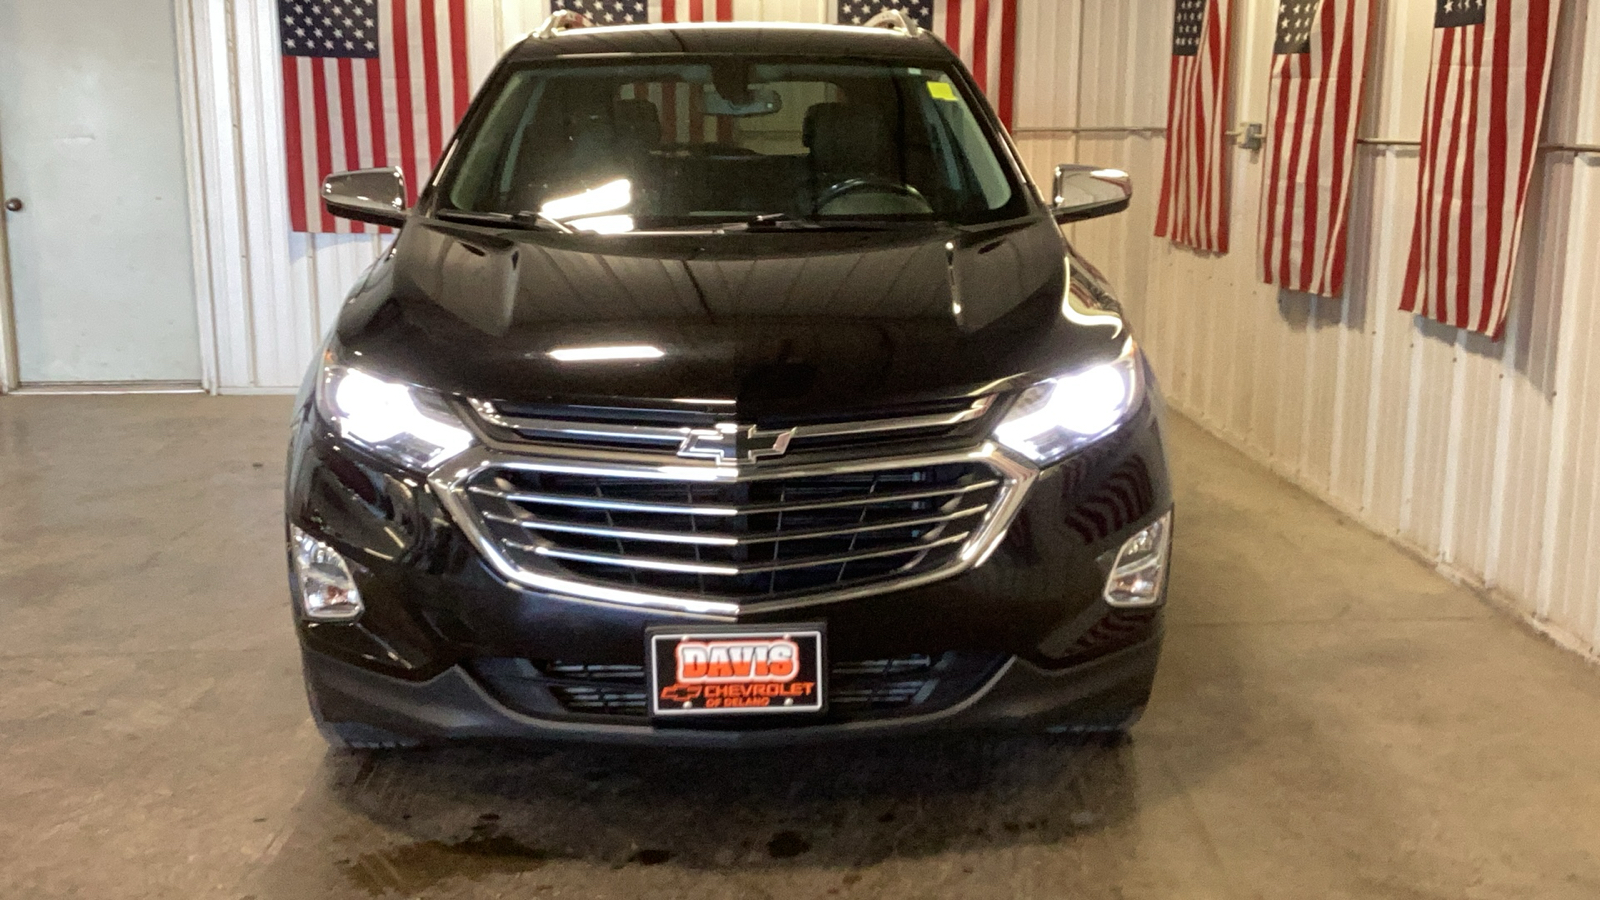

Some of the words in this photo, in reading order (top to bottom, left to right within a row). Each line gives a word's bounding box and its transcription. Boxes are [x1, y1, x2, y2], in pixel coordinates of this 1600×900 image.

[681, 642, 795, 680] DAVIS
[704, 682, 816, 696] CHEVROLET
[706, 697, 721, 708] OF
